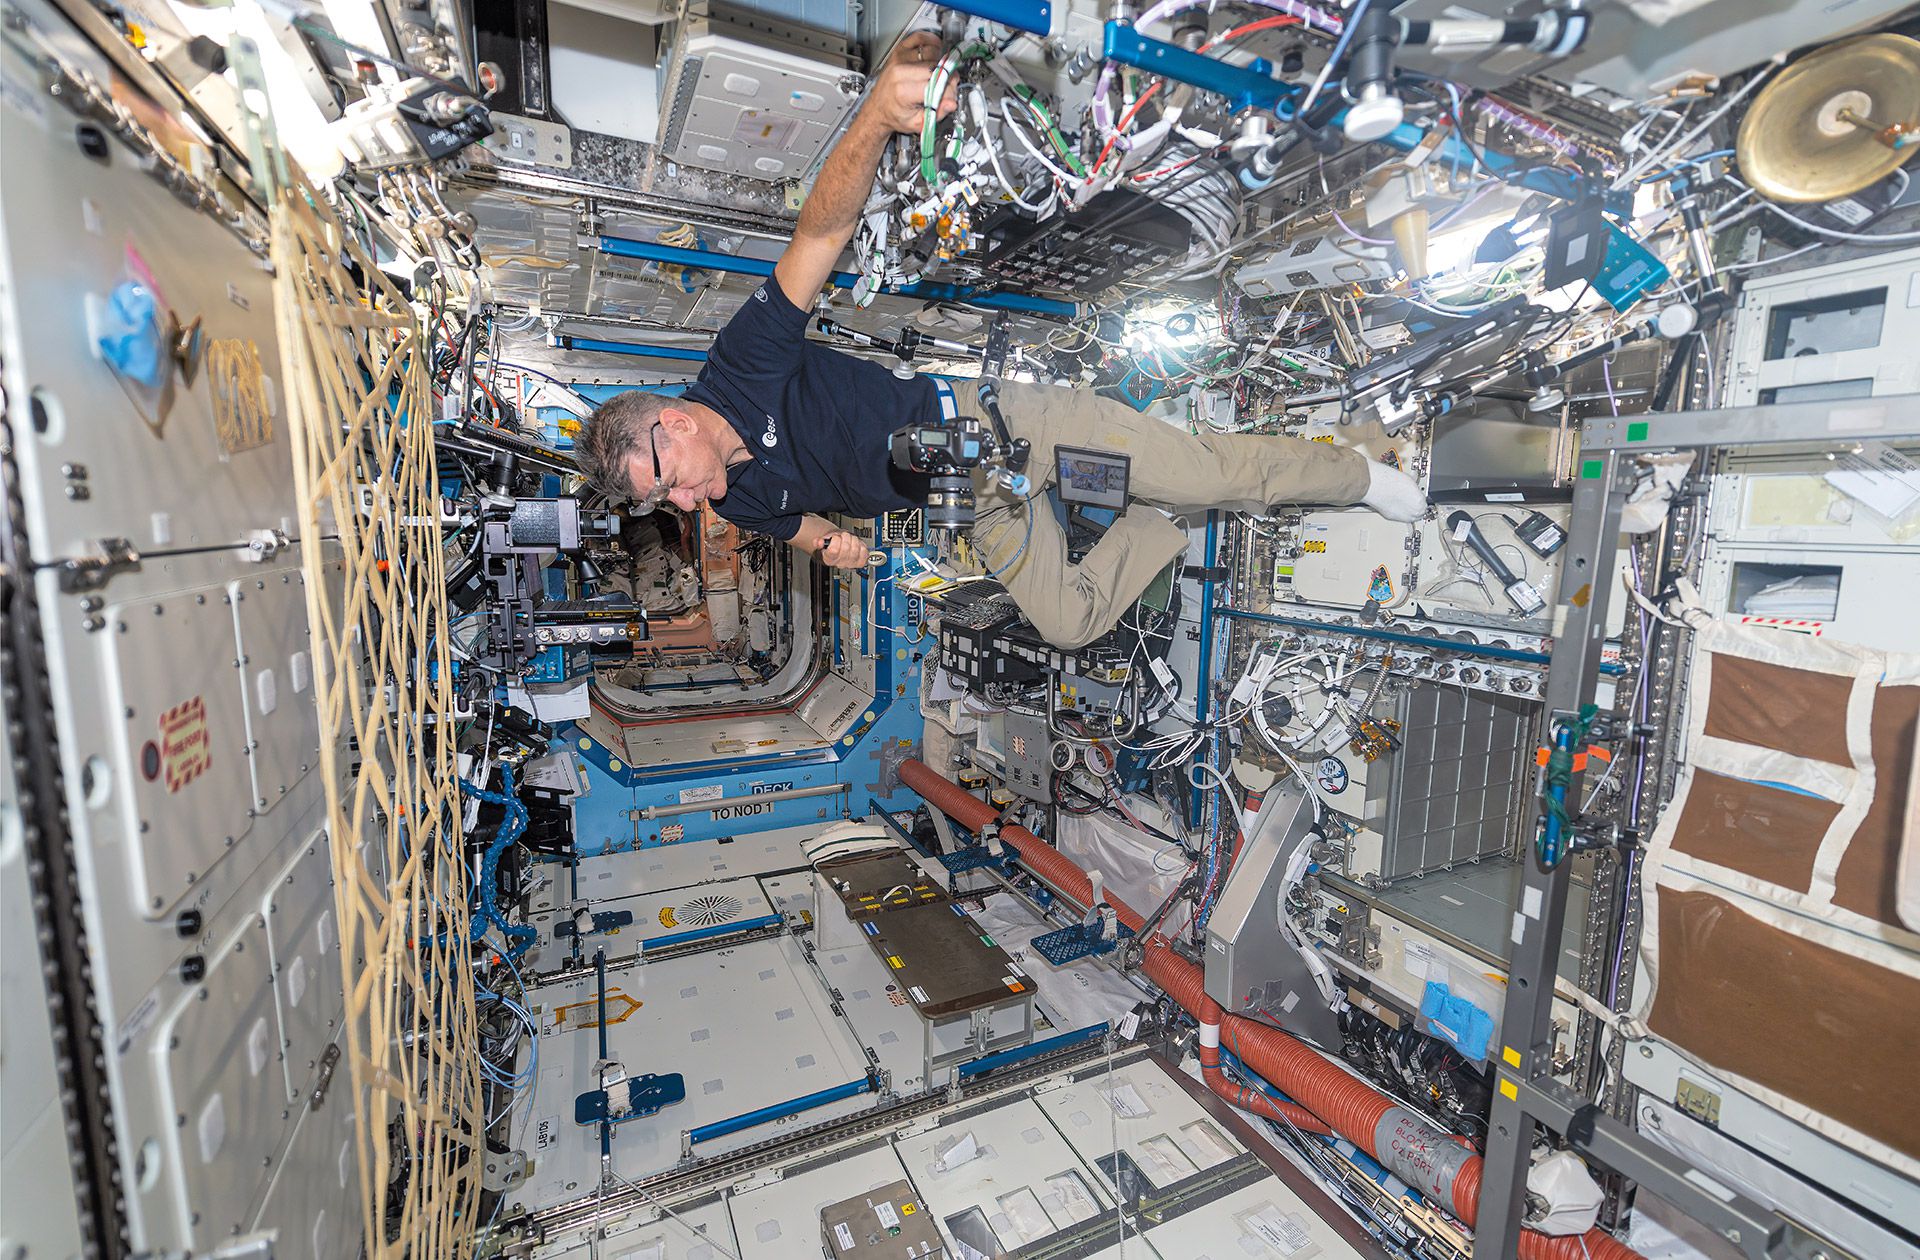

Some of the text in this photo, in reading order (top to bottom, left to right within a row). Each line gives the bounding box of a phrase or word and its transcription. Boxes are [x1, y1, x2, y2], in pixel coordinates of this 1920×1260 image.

[712, 801, 772, 821] TO NOD 1
[1395, 1126, 1434, 1154] BLOCK
[1400, 1117, 1439, 1143] DO NOT
[1406, 1150, 1436, 1176] PORT
